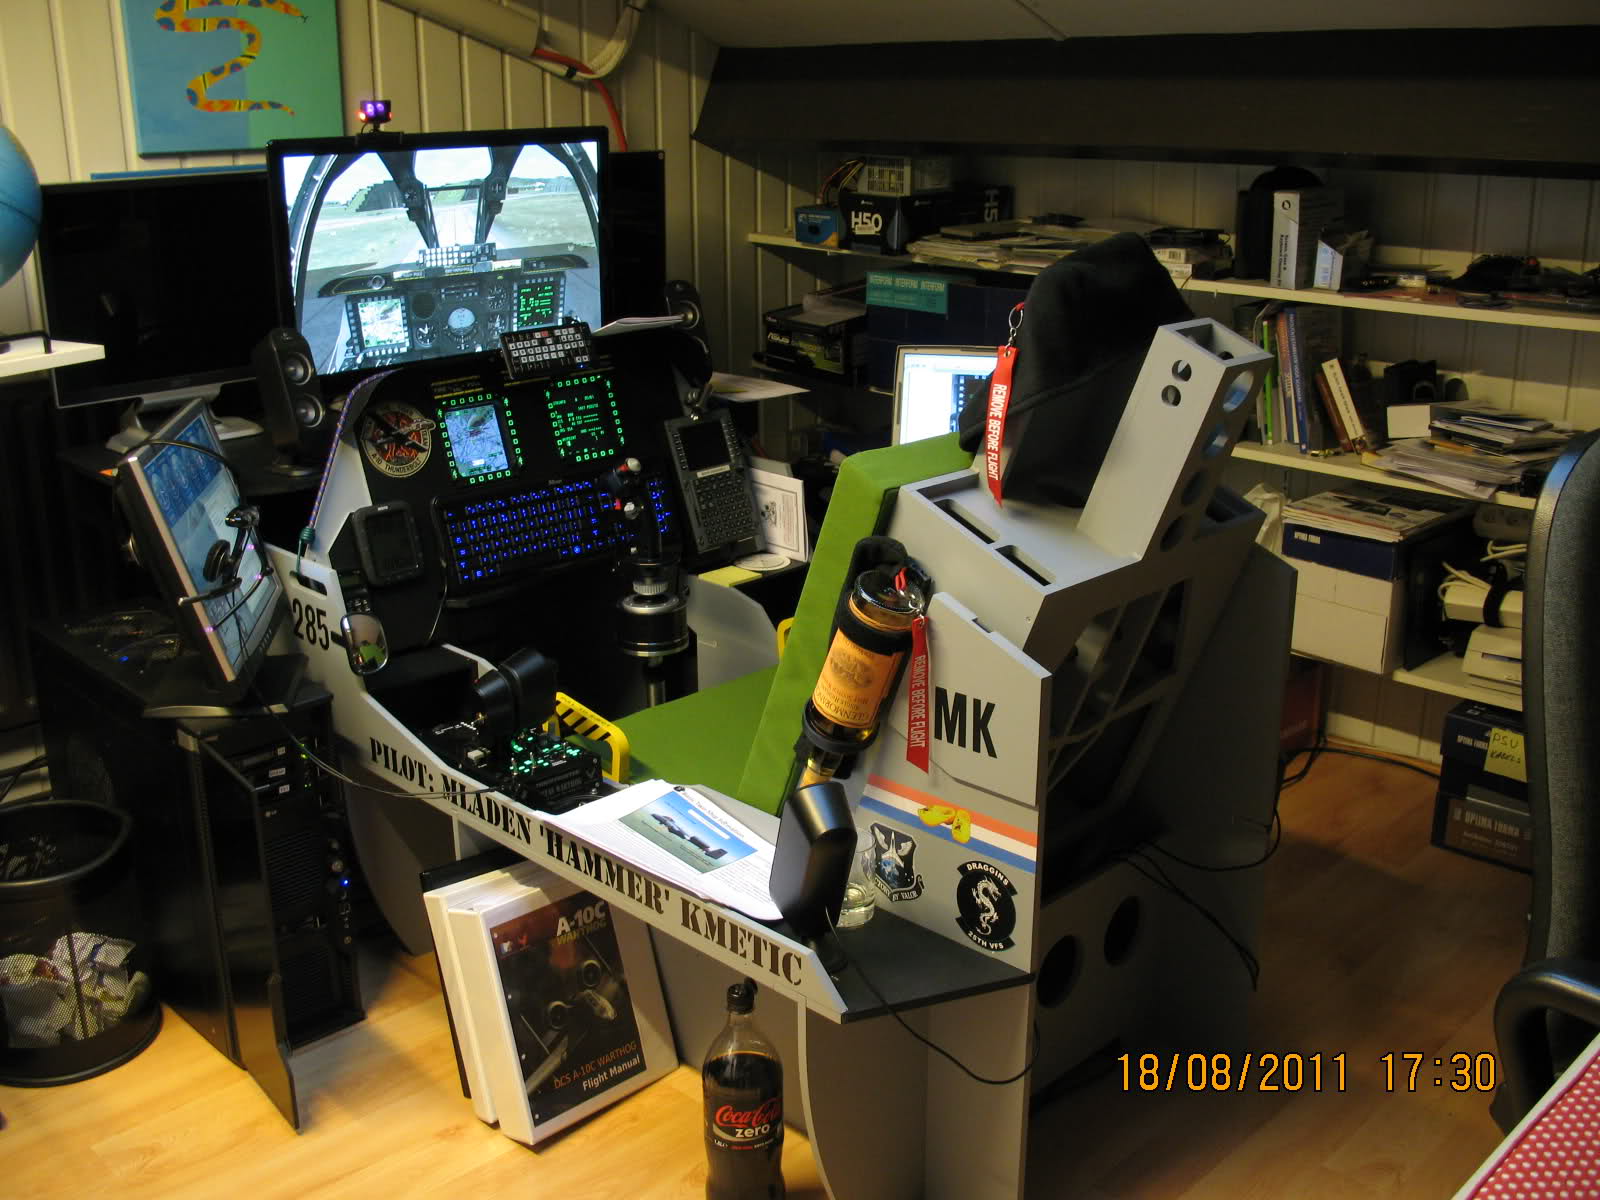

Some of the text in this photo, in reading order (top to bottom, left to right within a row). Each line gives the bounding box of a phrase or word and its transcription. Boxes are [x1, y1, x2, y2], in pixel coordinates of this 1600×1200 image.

[851, 211, 883, 234] H50
[984, 189, 999, 223] H5
[987, 383, 1008, 481] REMOVE BEFORE FLIGHT
[292, 597, 330, 651] 285
[910, 654, 926, 749] REMOVE BEFORE FLIGHT
[933, 685, 998, 759] MK
[369, 736, 434, 793] PILOT:
[440, 772, 532, 845] MLADEN
[539, 824, 670, 915] 'HAMMER'
[680, 896, 802, 986] KMETIC
[966, 862, 1009, 886] DRAGGINS
[900, 890, 919, 900] VALOR
[556, 900, 607, 937] A-10C
[557, 921, 608, 945] WARTHOG
[553, 1040, 638, 1090] DCS A-10C WARTHOG
[582, 1055, 641, 1091] Flight Manual
[735, 1123, 770, 1138] zero
